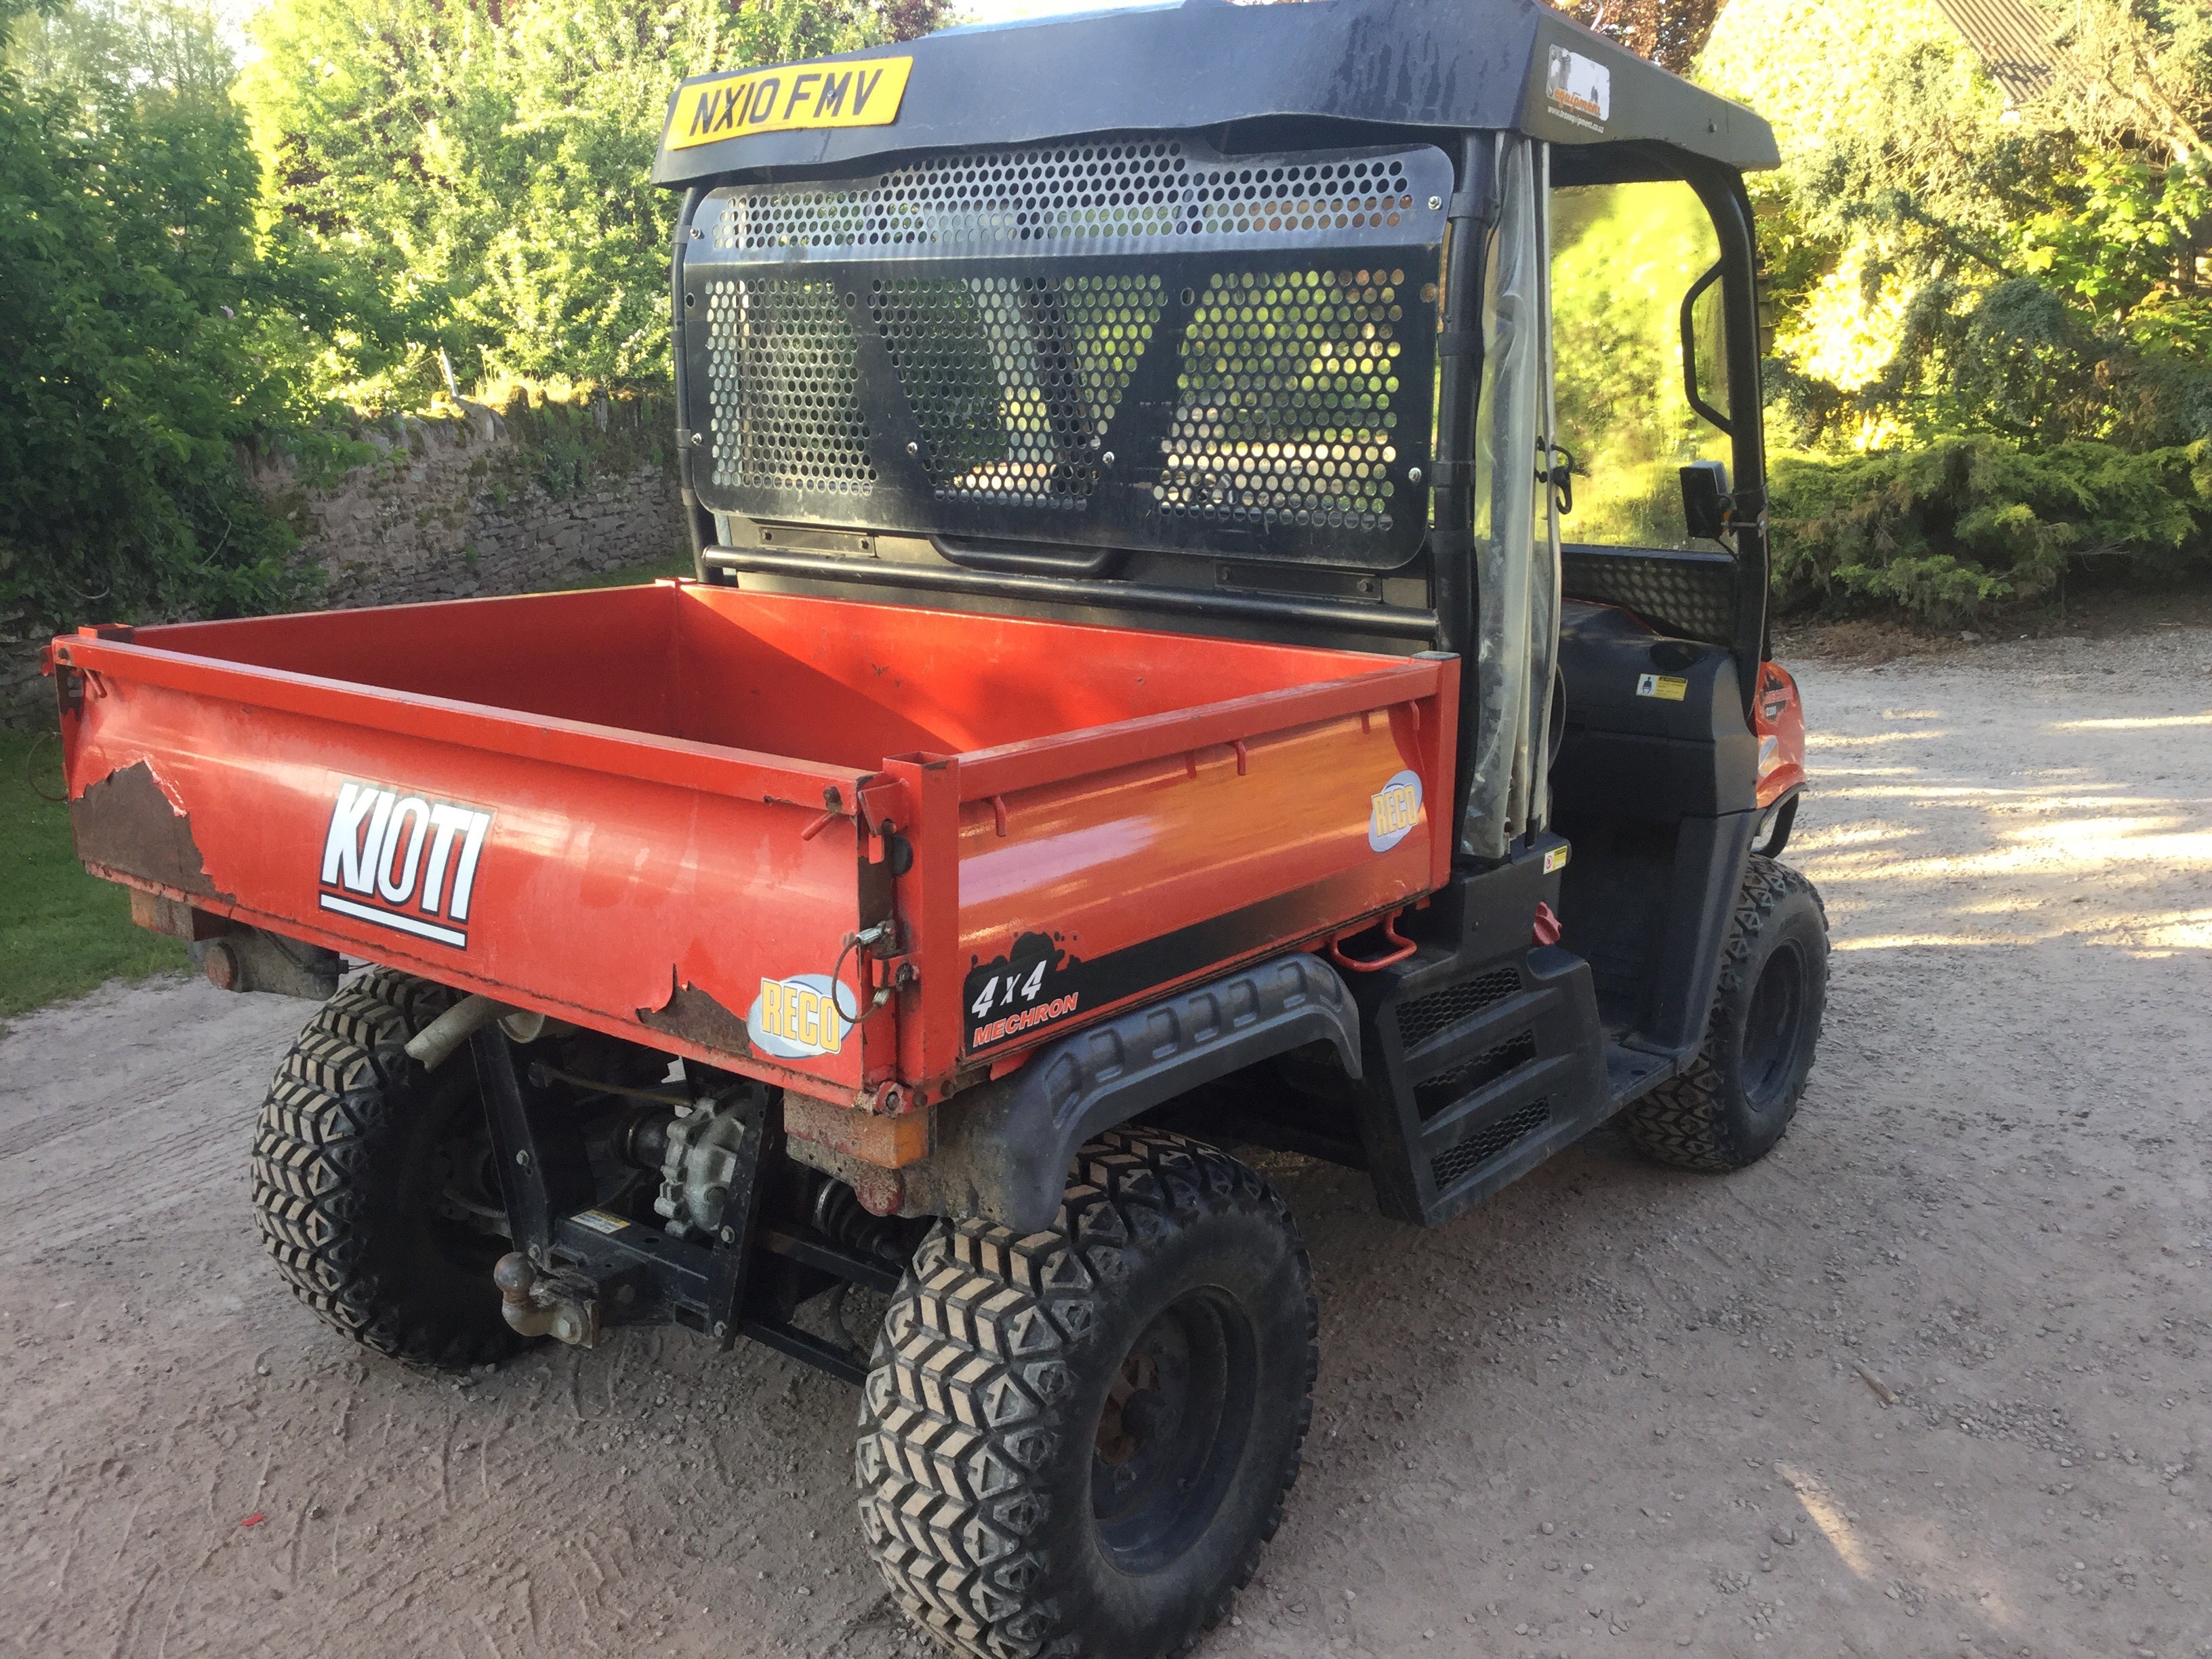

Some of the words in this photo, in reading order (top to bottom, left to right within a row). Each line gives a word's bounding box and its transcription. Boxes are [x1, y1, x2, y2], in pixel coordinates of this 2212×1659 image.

[689, 77, 781, 137] NX10
[783, 68, 884, 121] FMV
[1372, 784, 1418, 838] RECO
[321, 782, 491, 923] KIOTI
[761, 979, 841, 1052] RECO
[972, 991, 1079, 1048] MECHRON
